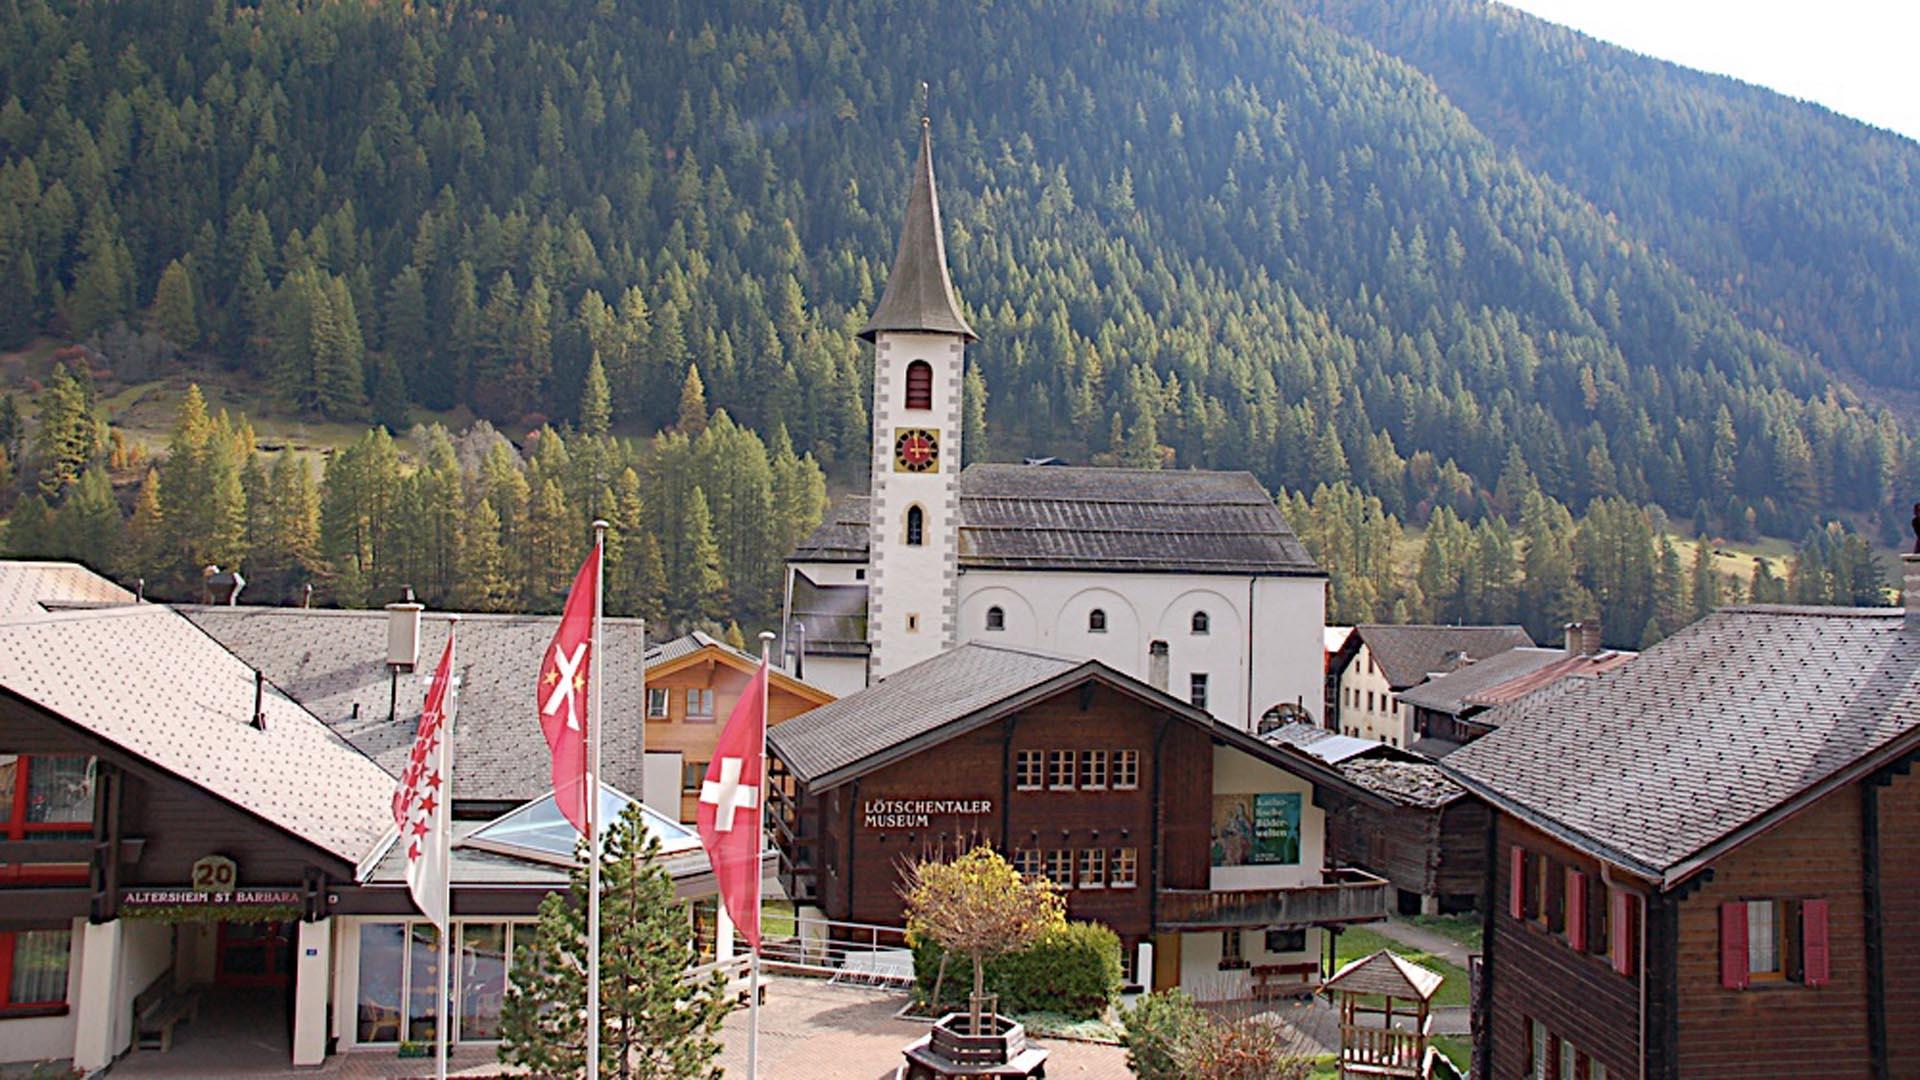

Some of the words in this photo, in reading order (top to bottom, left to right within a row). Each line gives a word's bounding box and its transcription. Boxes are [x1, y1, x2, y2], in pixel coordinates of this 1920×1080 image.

[865, 799, 992, 813] LÖTSCHENTALER
[864, 815, 929, 827] MUSEUM
[1256, 829, 1287, 837] welten
[197, 864, 232, 885] 20
[125, 892, 209, 903] ALTERSHEIM
[214, 892, 231, 902] ST
[236, 892, 299, 902] BARBARA
